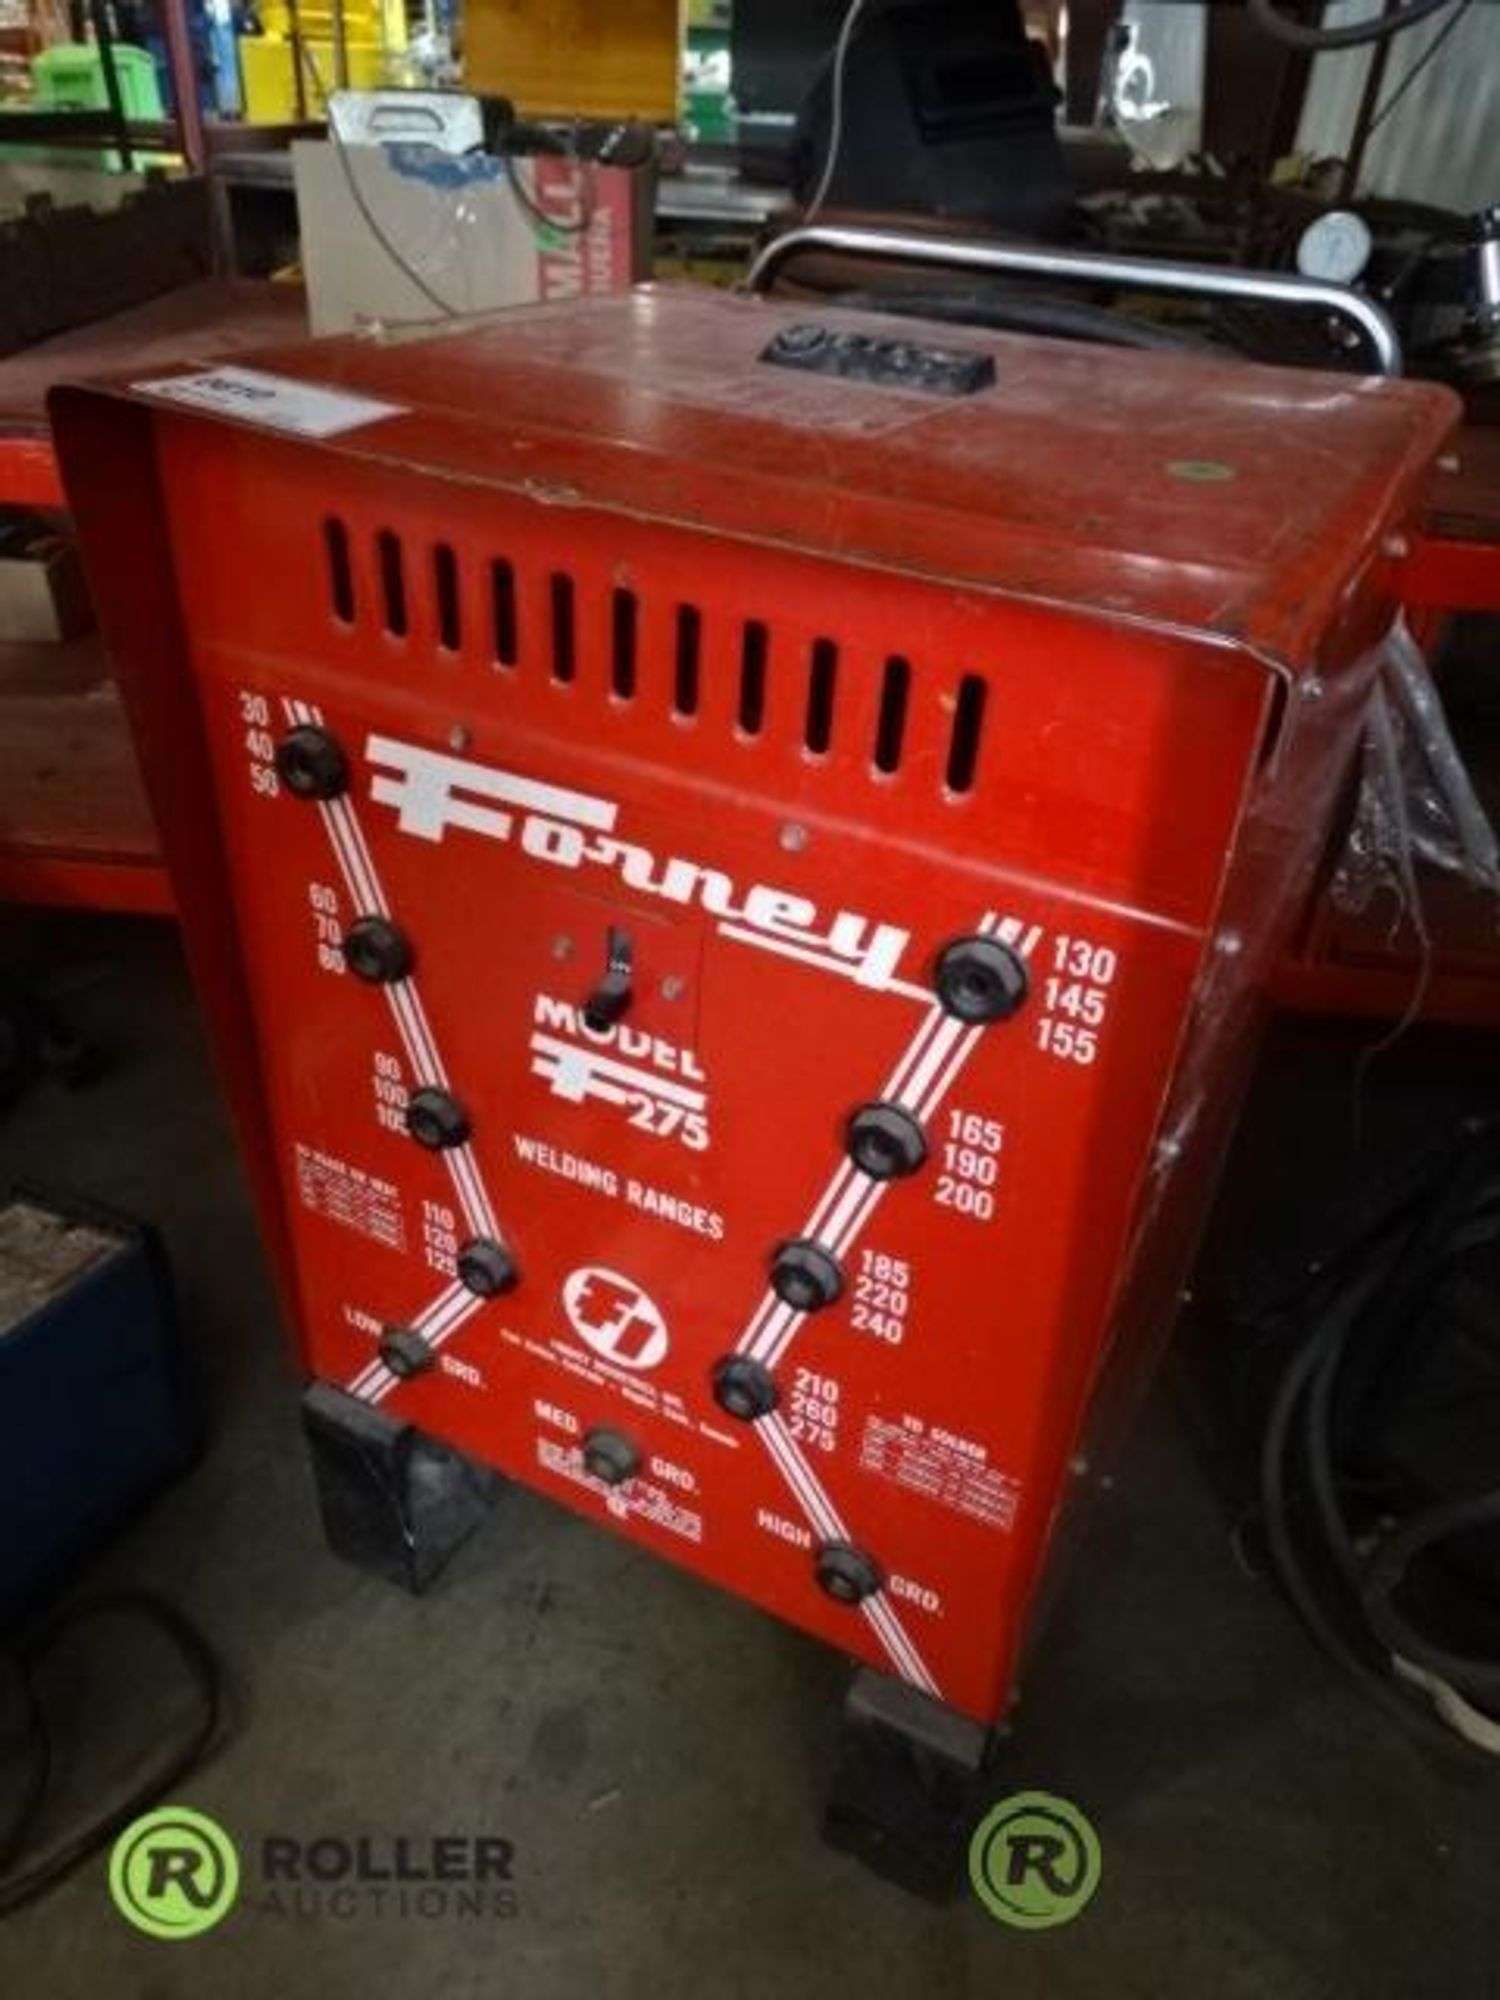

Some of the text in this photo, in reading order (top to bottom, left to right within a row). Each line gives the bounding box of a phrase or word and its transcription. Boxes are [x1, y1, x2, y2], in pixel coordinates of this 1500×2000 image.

[364, 732, 912, 992] Forney
[1053, 935, 1117, 986] 130
[1043, 977, 1107, 1026] 145
[1037, 1017, 1099, 1066] 155
[948, 1109, 1004, 1153] 165
[942, 1143, 998, 1186] 190
[513, 1134, 724, 1241] WELDING RANGES
[935, 1175, 994, 1221] 200
[861, 1248, 909, 1289] 185
[856, 1275, 908, 1317] 220
[850, 1303, 904, 1346] 240
[793, 1367, 839, 1402] 210
[790, 1391, 838, 1429] 260
[757, 1508, 812, 1548] HIGH
